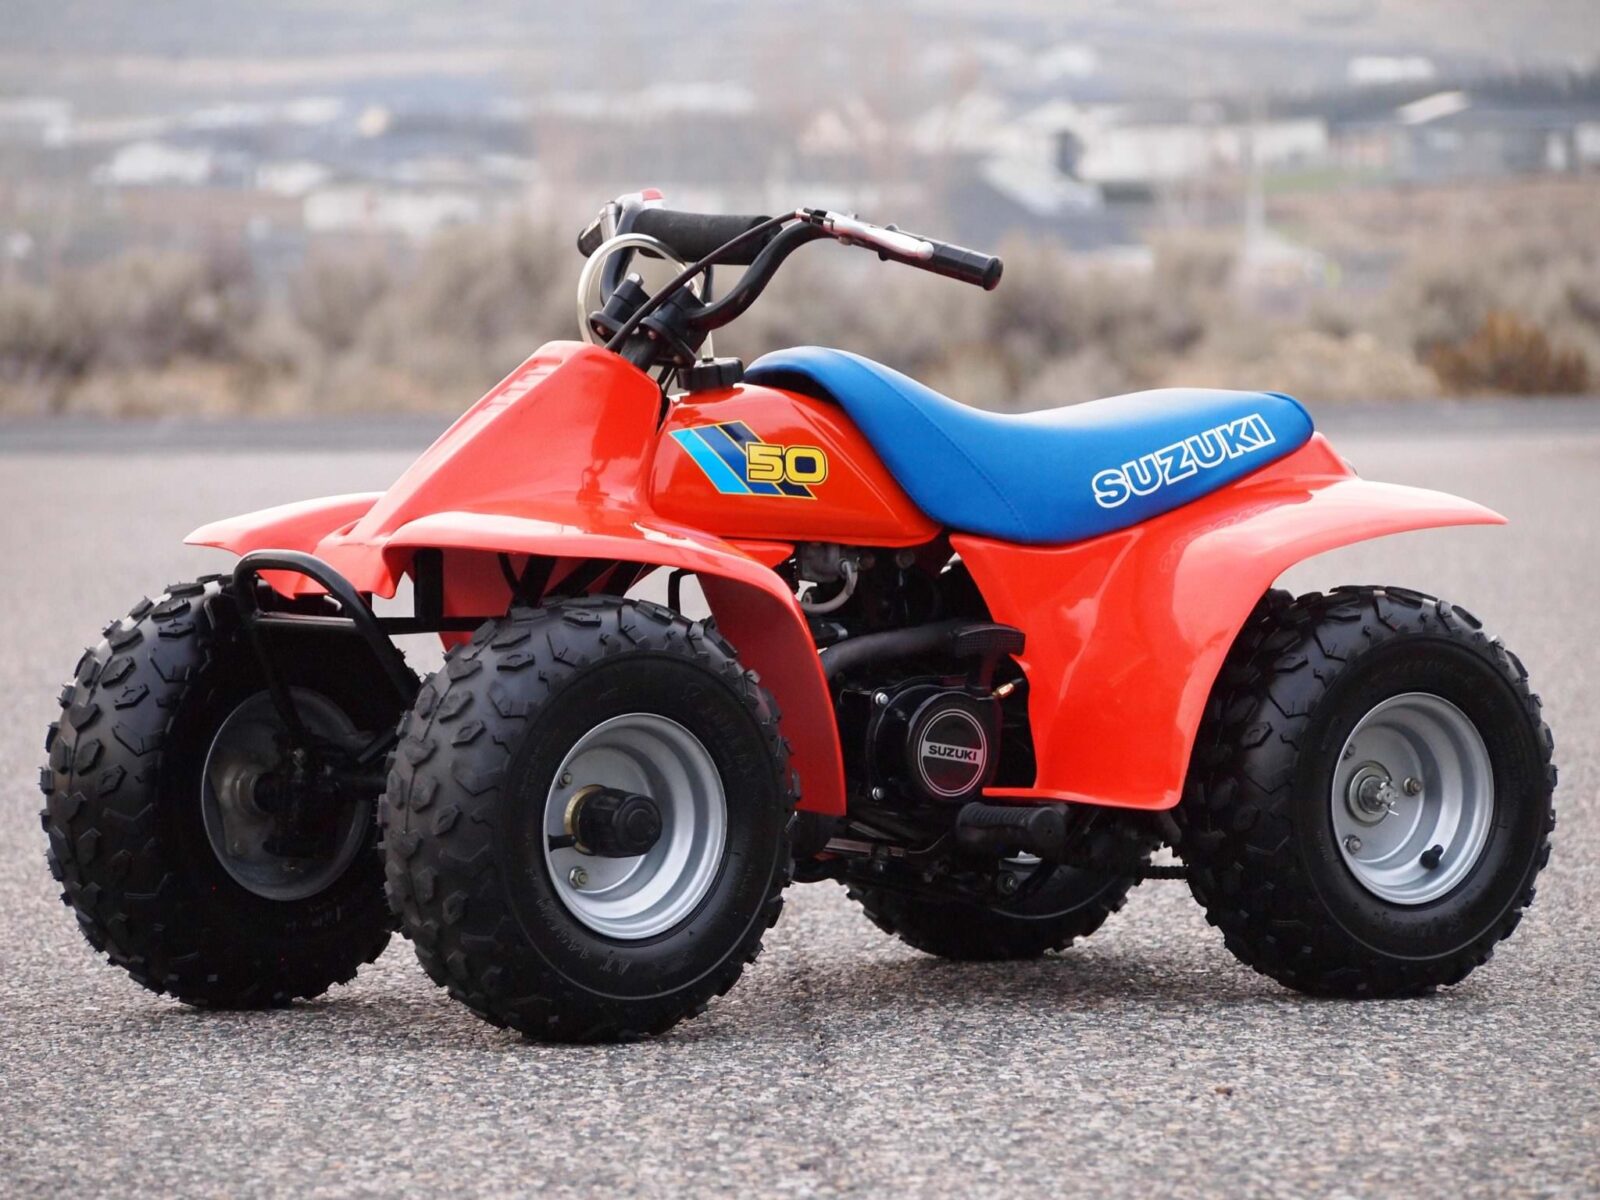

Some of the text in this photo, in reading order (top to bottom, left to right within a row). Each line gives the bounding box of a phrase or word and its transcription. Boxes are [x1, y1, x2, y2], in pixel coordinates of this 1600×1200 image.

[746, 442, 828, 485] 50
[1091, 413, 1276, 509] SUZUKI
[928, 745, 977, 761] SUZUKI
